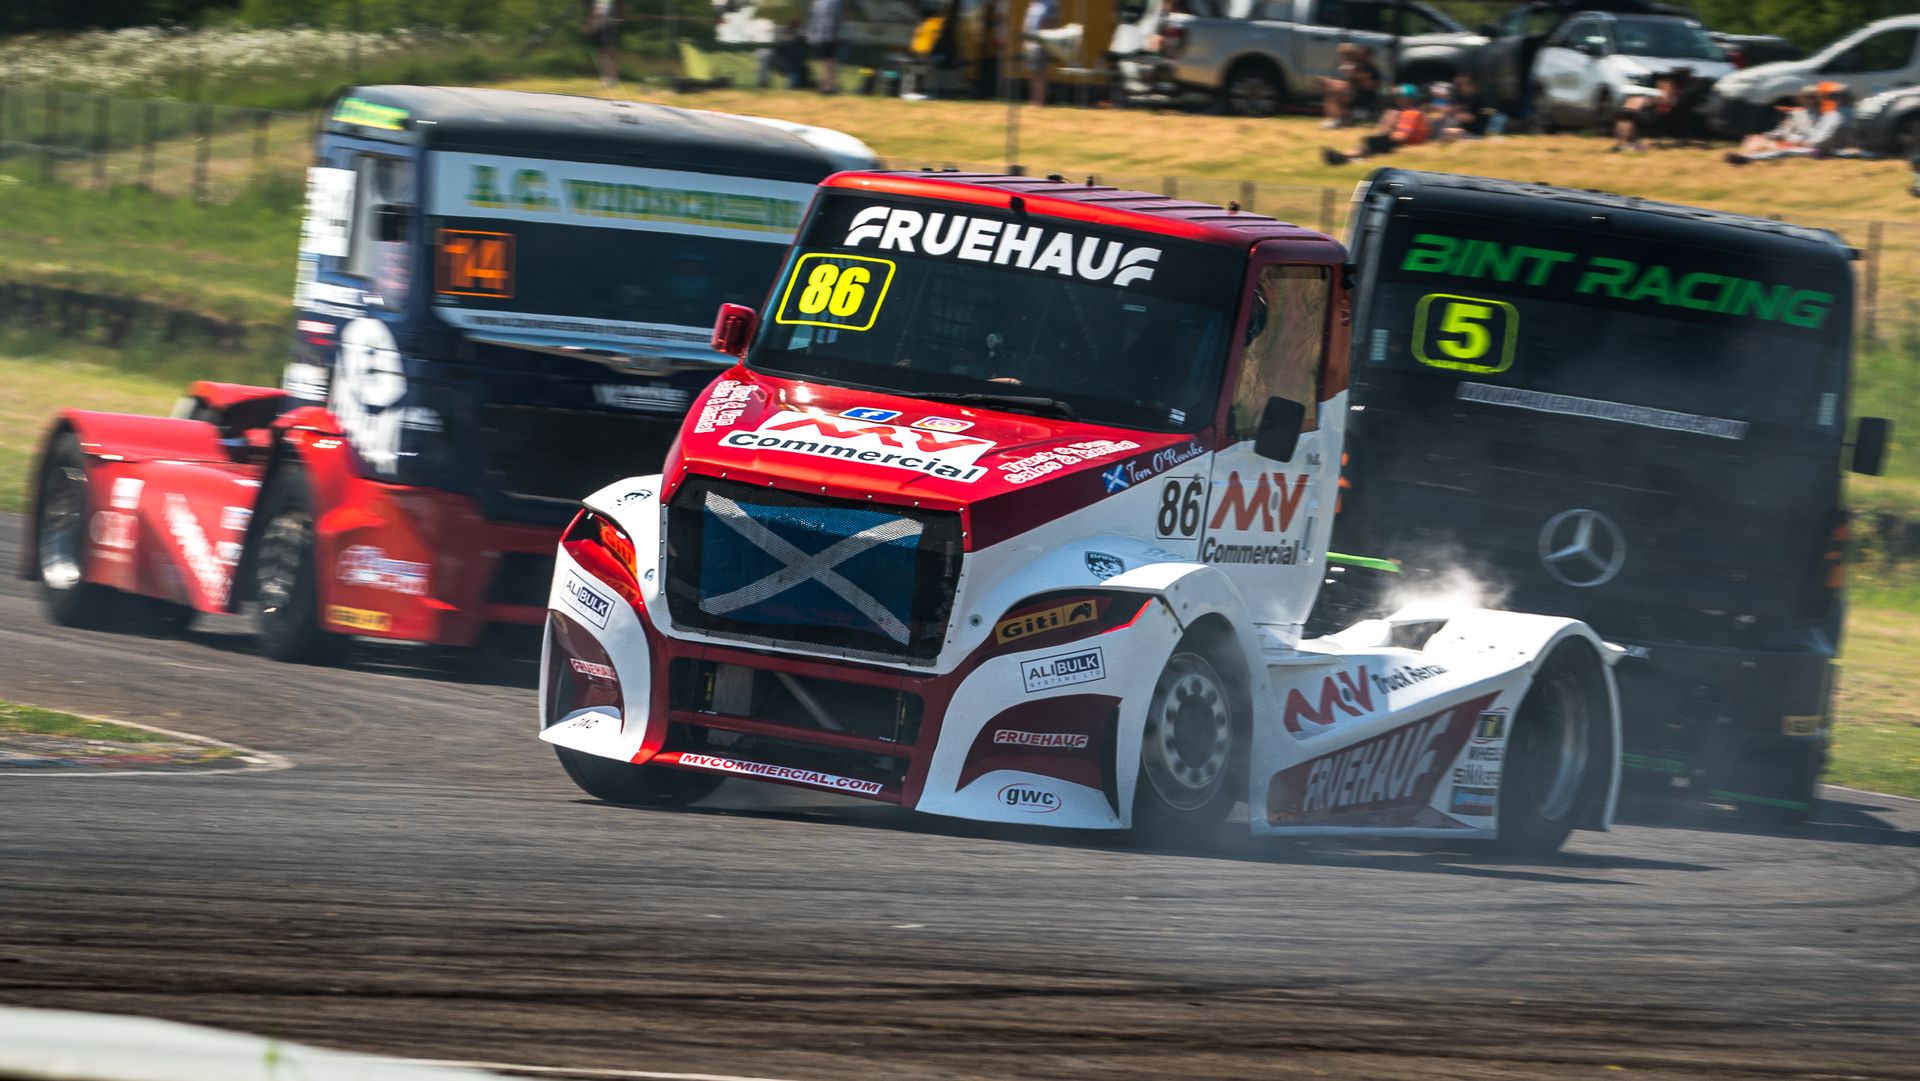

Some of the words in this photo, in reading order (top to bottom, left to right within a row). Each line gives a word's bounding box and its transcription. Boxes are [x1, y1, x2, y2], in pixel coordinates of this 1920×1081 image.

[843, 206, 1162, 287] FRUEHAUF
[798, 263, 871, 317] 86
[1400, 233, 1577, 286] BINT
[1575, 256, 1836, 329] RACING
[1436, 302, 1494, 360] 5
[728, 433, 980, 480] Commercial
[765, 417, 988, 453] MV
[1126, 460, 1153, 483] Tom
[1157, 479, 1203, 537] 86
[1208, 470, 1310, 533] MV
[1202, 536, 1301, 565] Commercial
[1002, 612, 1059, 639] Giti
[1283, 665, 1375, 733] MV
[995, 731, 1087, 747] FRUEHAUF
[1303, 709, 1456, 811] FRUEHAUF
[683, 754, 881, 793] MVCOMMERCIAL.COM
[1006, 788, 1055, 806] gwc
